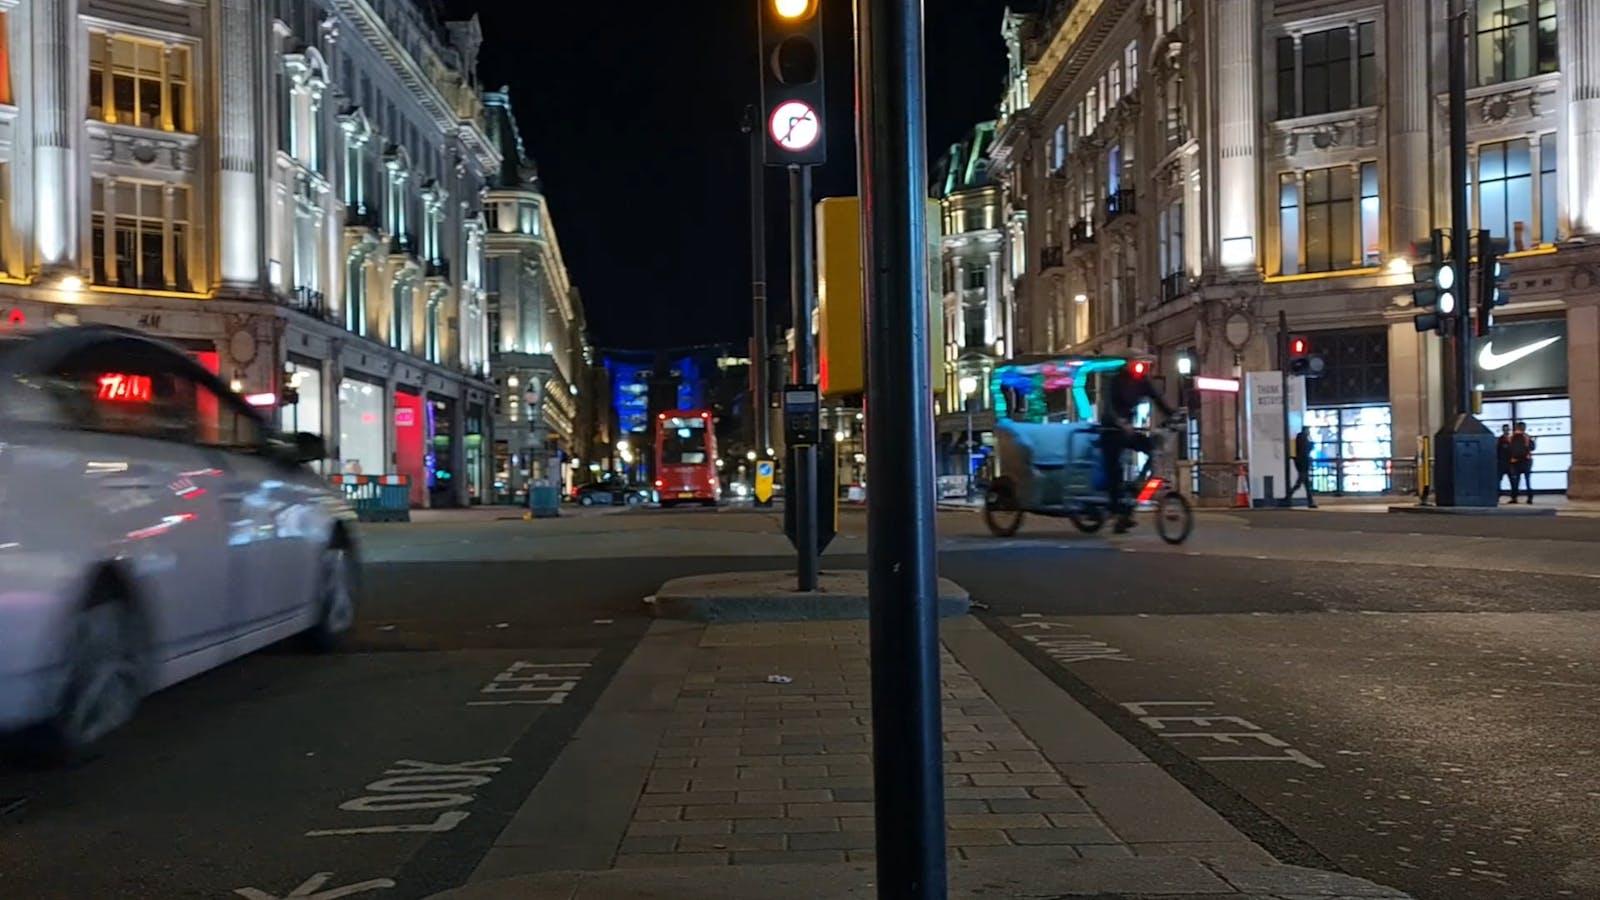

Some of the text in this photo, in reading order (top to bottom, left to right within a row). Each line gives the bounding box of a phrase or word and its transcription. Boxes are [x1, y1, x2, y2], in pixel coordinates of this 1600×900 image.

[305, 661, 592, 837] LOOK LEFT
[1022, 634, 1325, 769] LOOK LEFT
